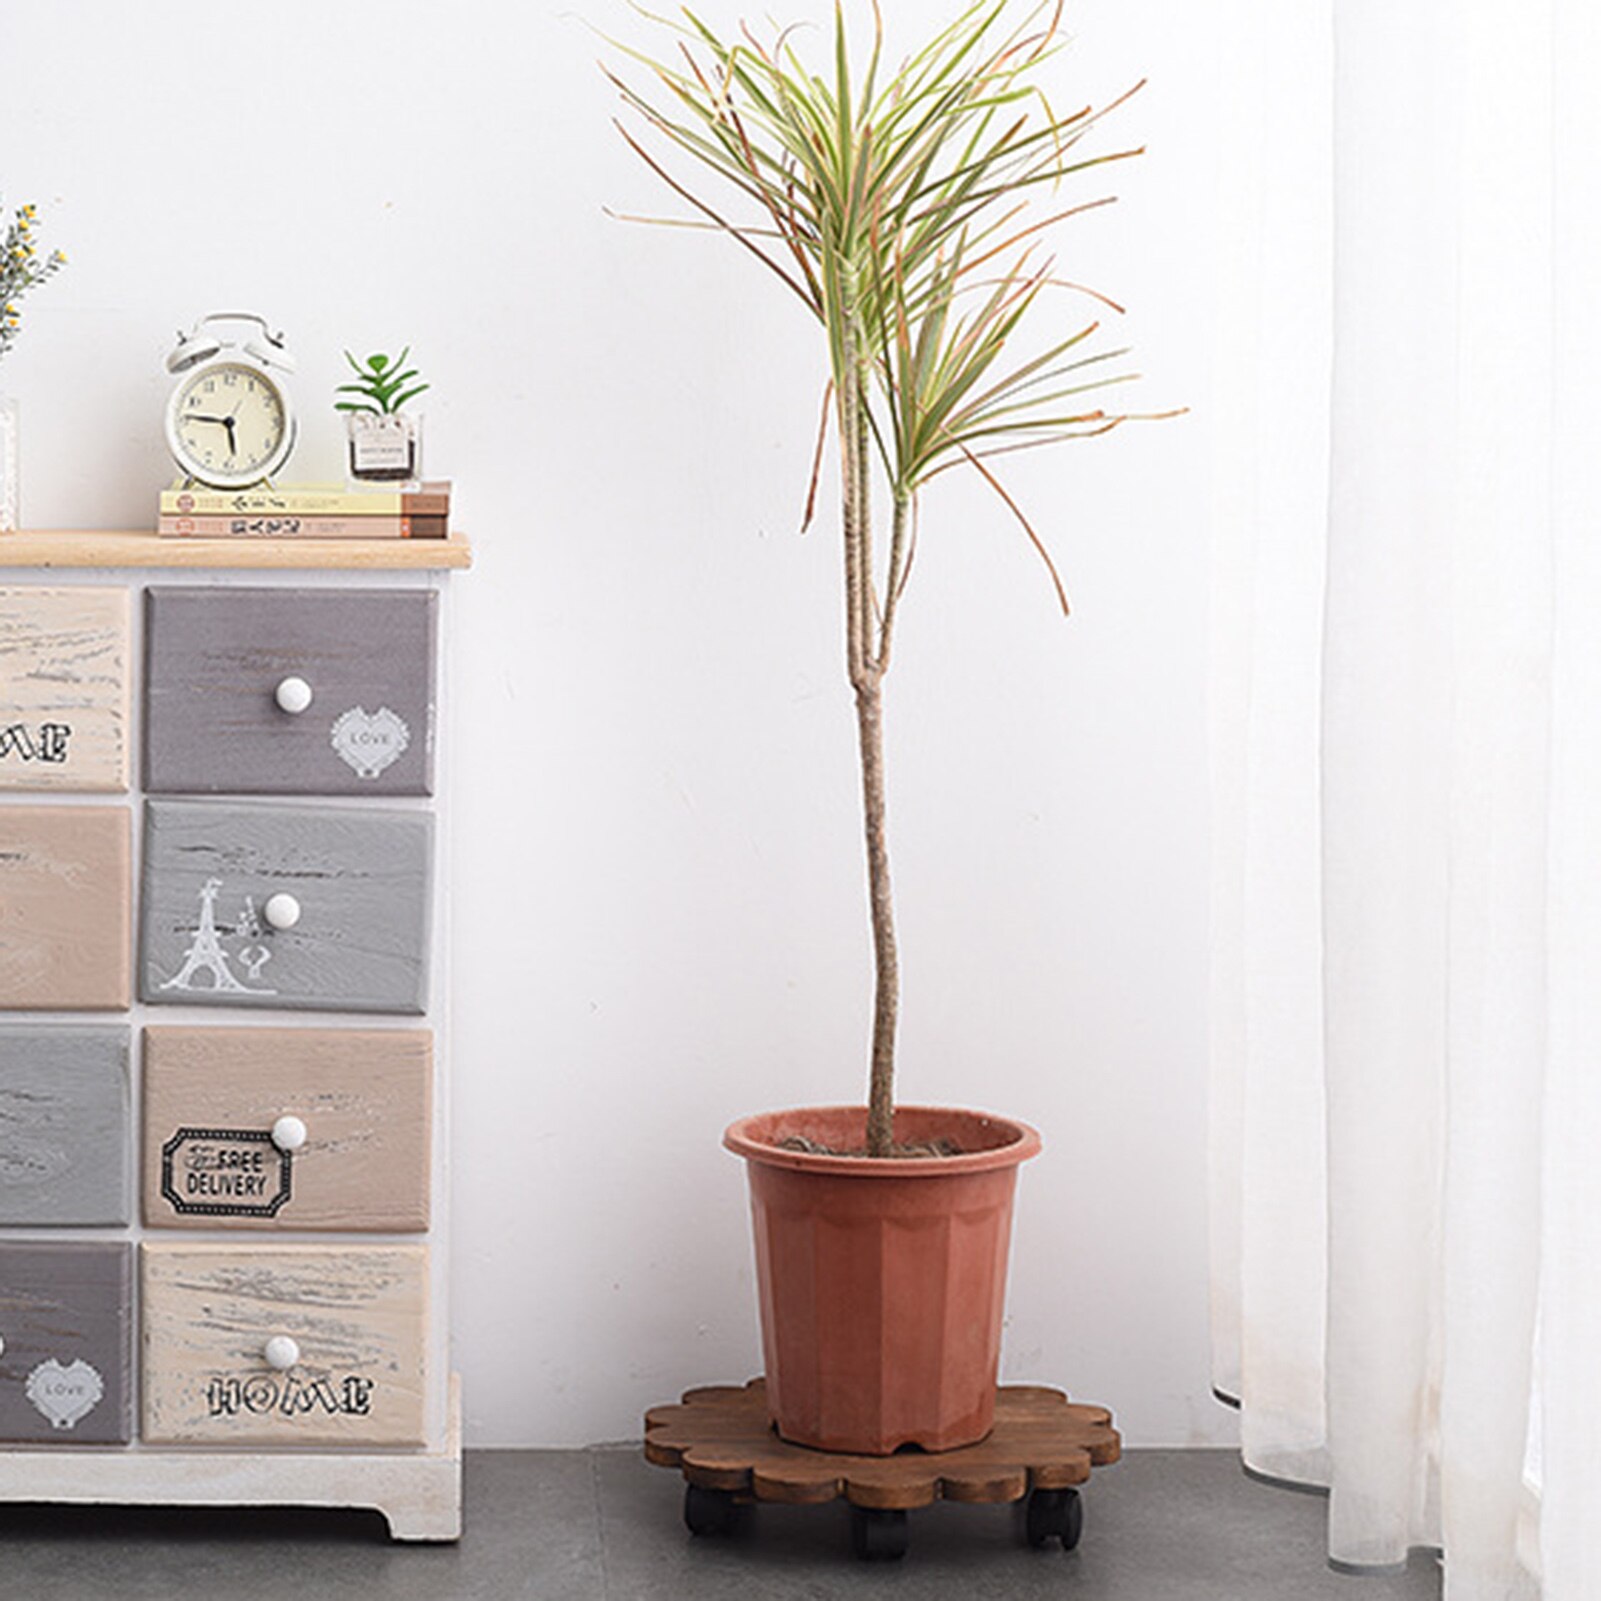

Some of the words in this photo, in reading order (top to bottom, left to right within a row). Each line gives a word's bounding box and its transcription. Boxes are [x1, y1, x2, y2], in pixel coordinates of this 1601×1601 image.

[350, 731, 390, 746] LOVE
[218, 1150, 262, 1173] FREE
[187, 1172, 267, 1196] DELIVERY
[206, 1375, 374, 1416] HOME
